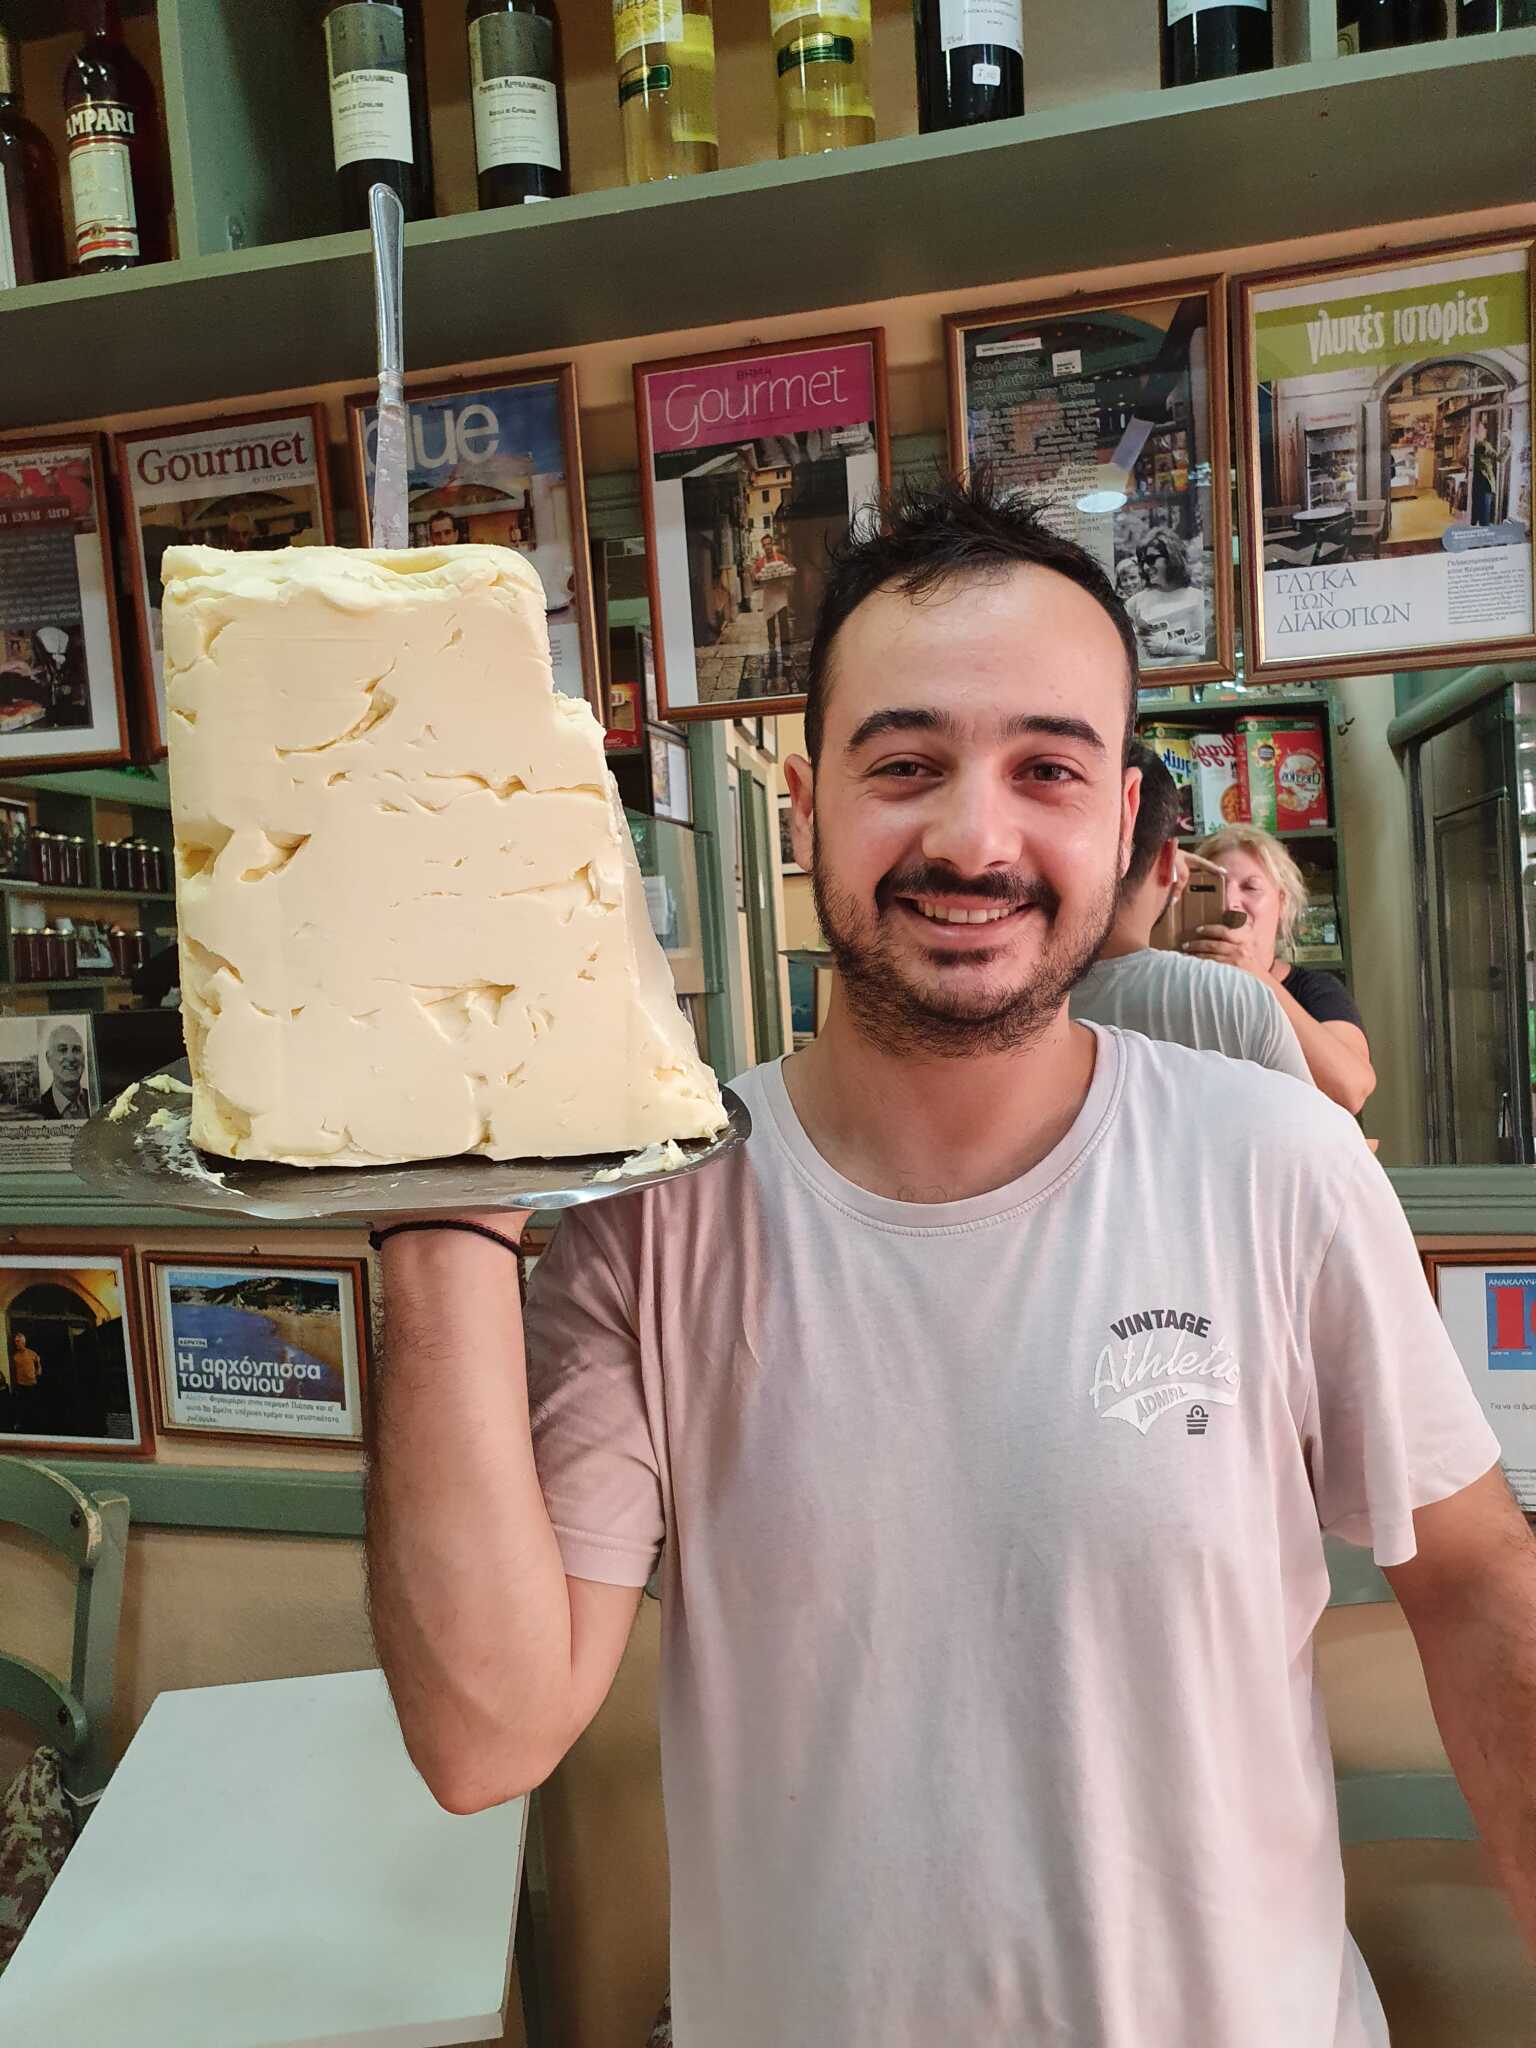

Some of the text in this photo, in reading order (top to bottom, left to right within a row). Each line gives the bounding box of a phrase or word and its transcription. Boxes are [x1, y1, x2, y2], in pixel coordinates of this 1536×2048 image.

[66, 107, 135, 138] AMPARI
[1306, 290, 1489, 364] γλυκές ιστορίες
[137, 431, 308, 485] Gourmet
[1275, 568, 1357, 594] ΓΛΥΚΑ
[1289, 591, 1336, 611] ΤΩΝ
[1277, 602, 1412, 634] ΔΙΑΚΟΠΩΝ
[1110, 1309, 1212, 1340] VINTAGE
[178, 1352, 321, 1380] Η αρχόντισσα
[179, 1373, 214, 1389] του
